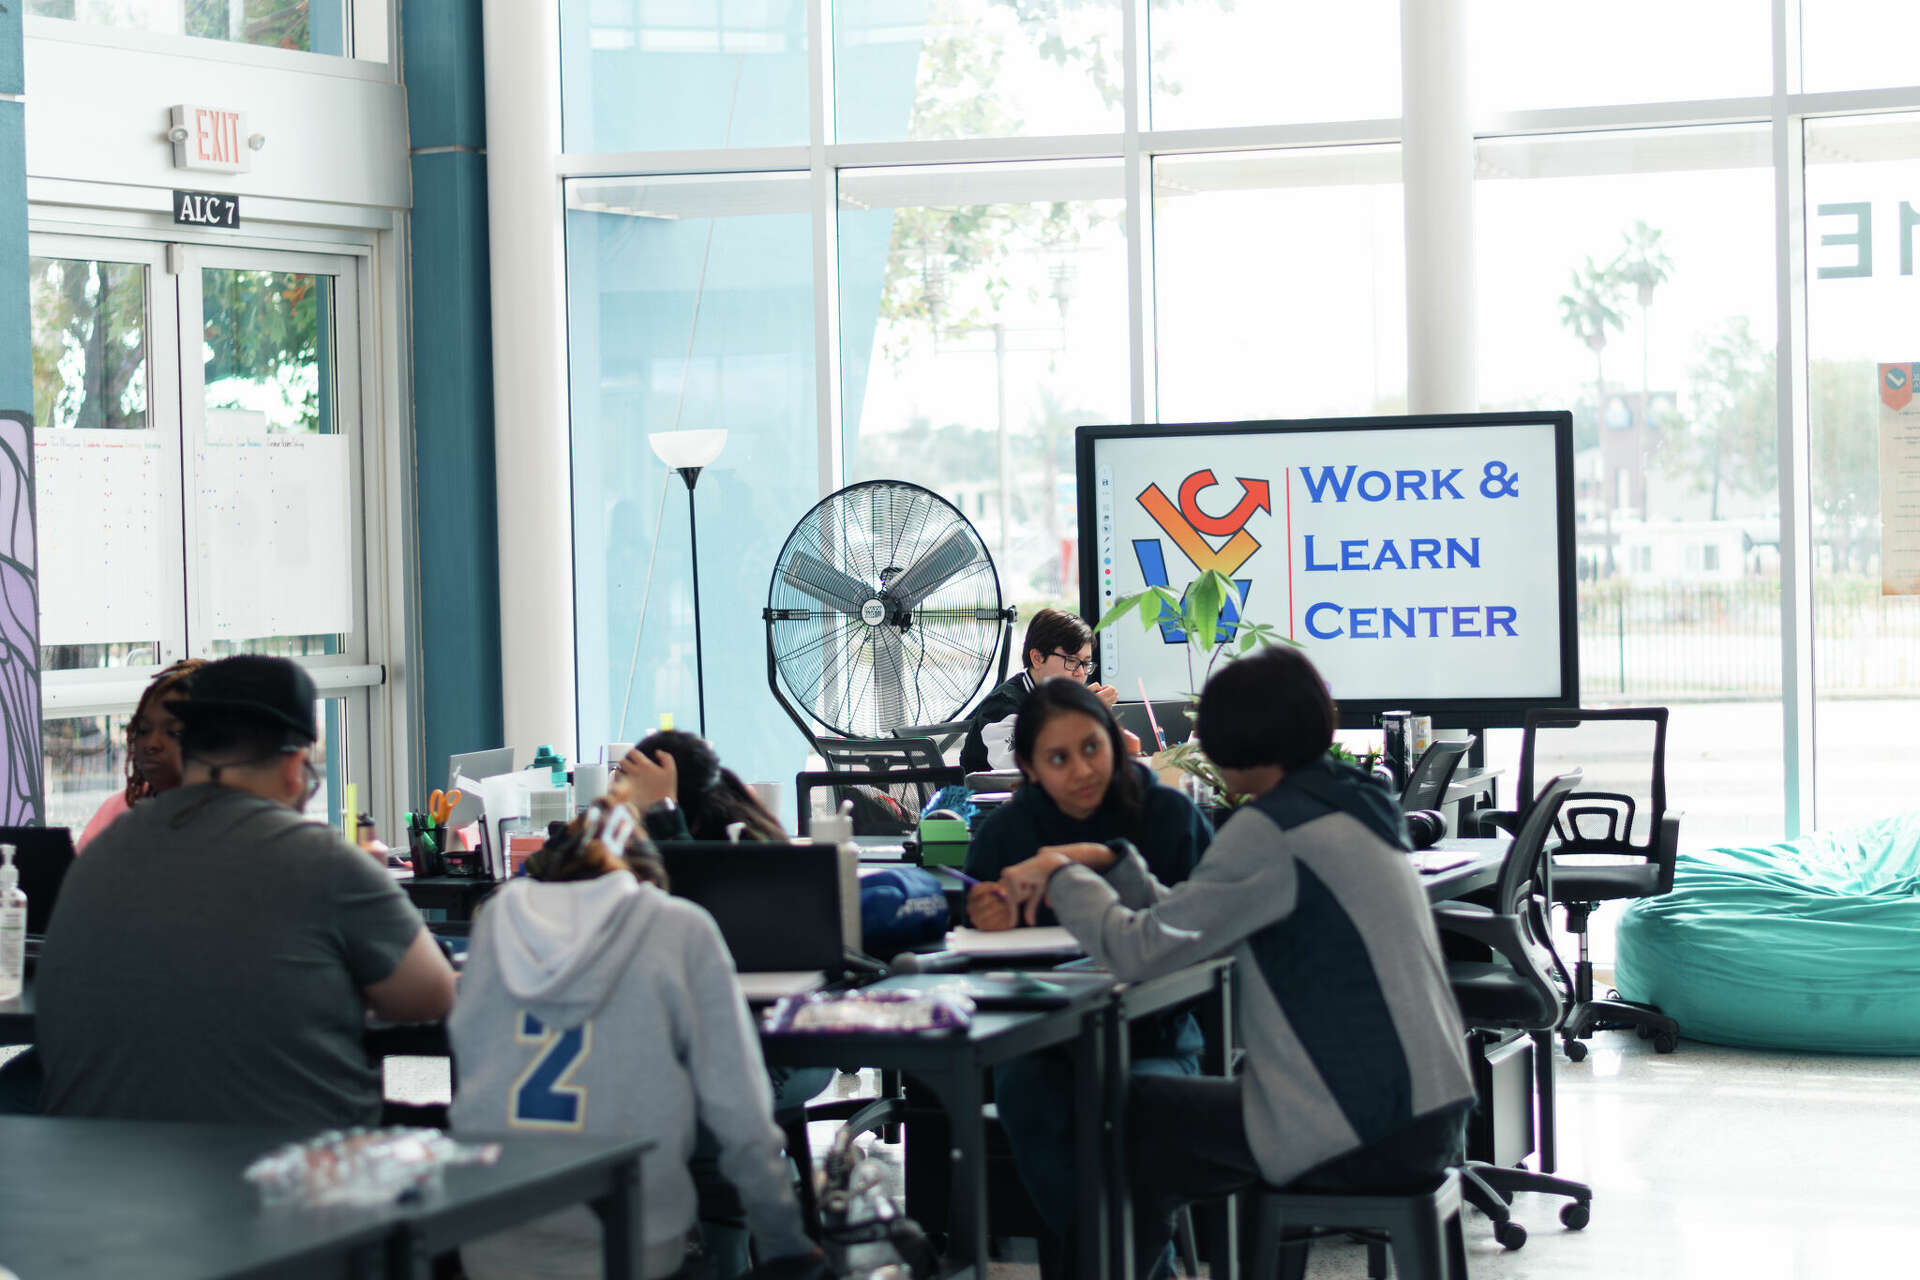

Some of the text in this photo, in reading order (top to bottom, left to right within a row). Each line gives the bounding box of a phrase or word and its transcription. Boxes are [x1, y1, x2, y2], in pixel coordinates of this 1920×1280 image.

[196, 109, 239, 163] EXIT
[180, 195, 235, 224] ALC 7
[1299, 461, 1519, 503] WORK &
[1304, 535, 1480, 571] LEARN
[1305, 602, 1519, 640] CENTER
